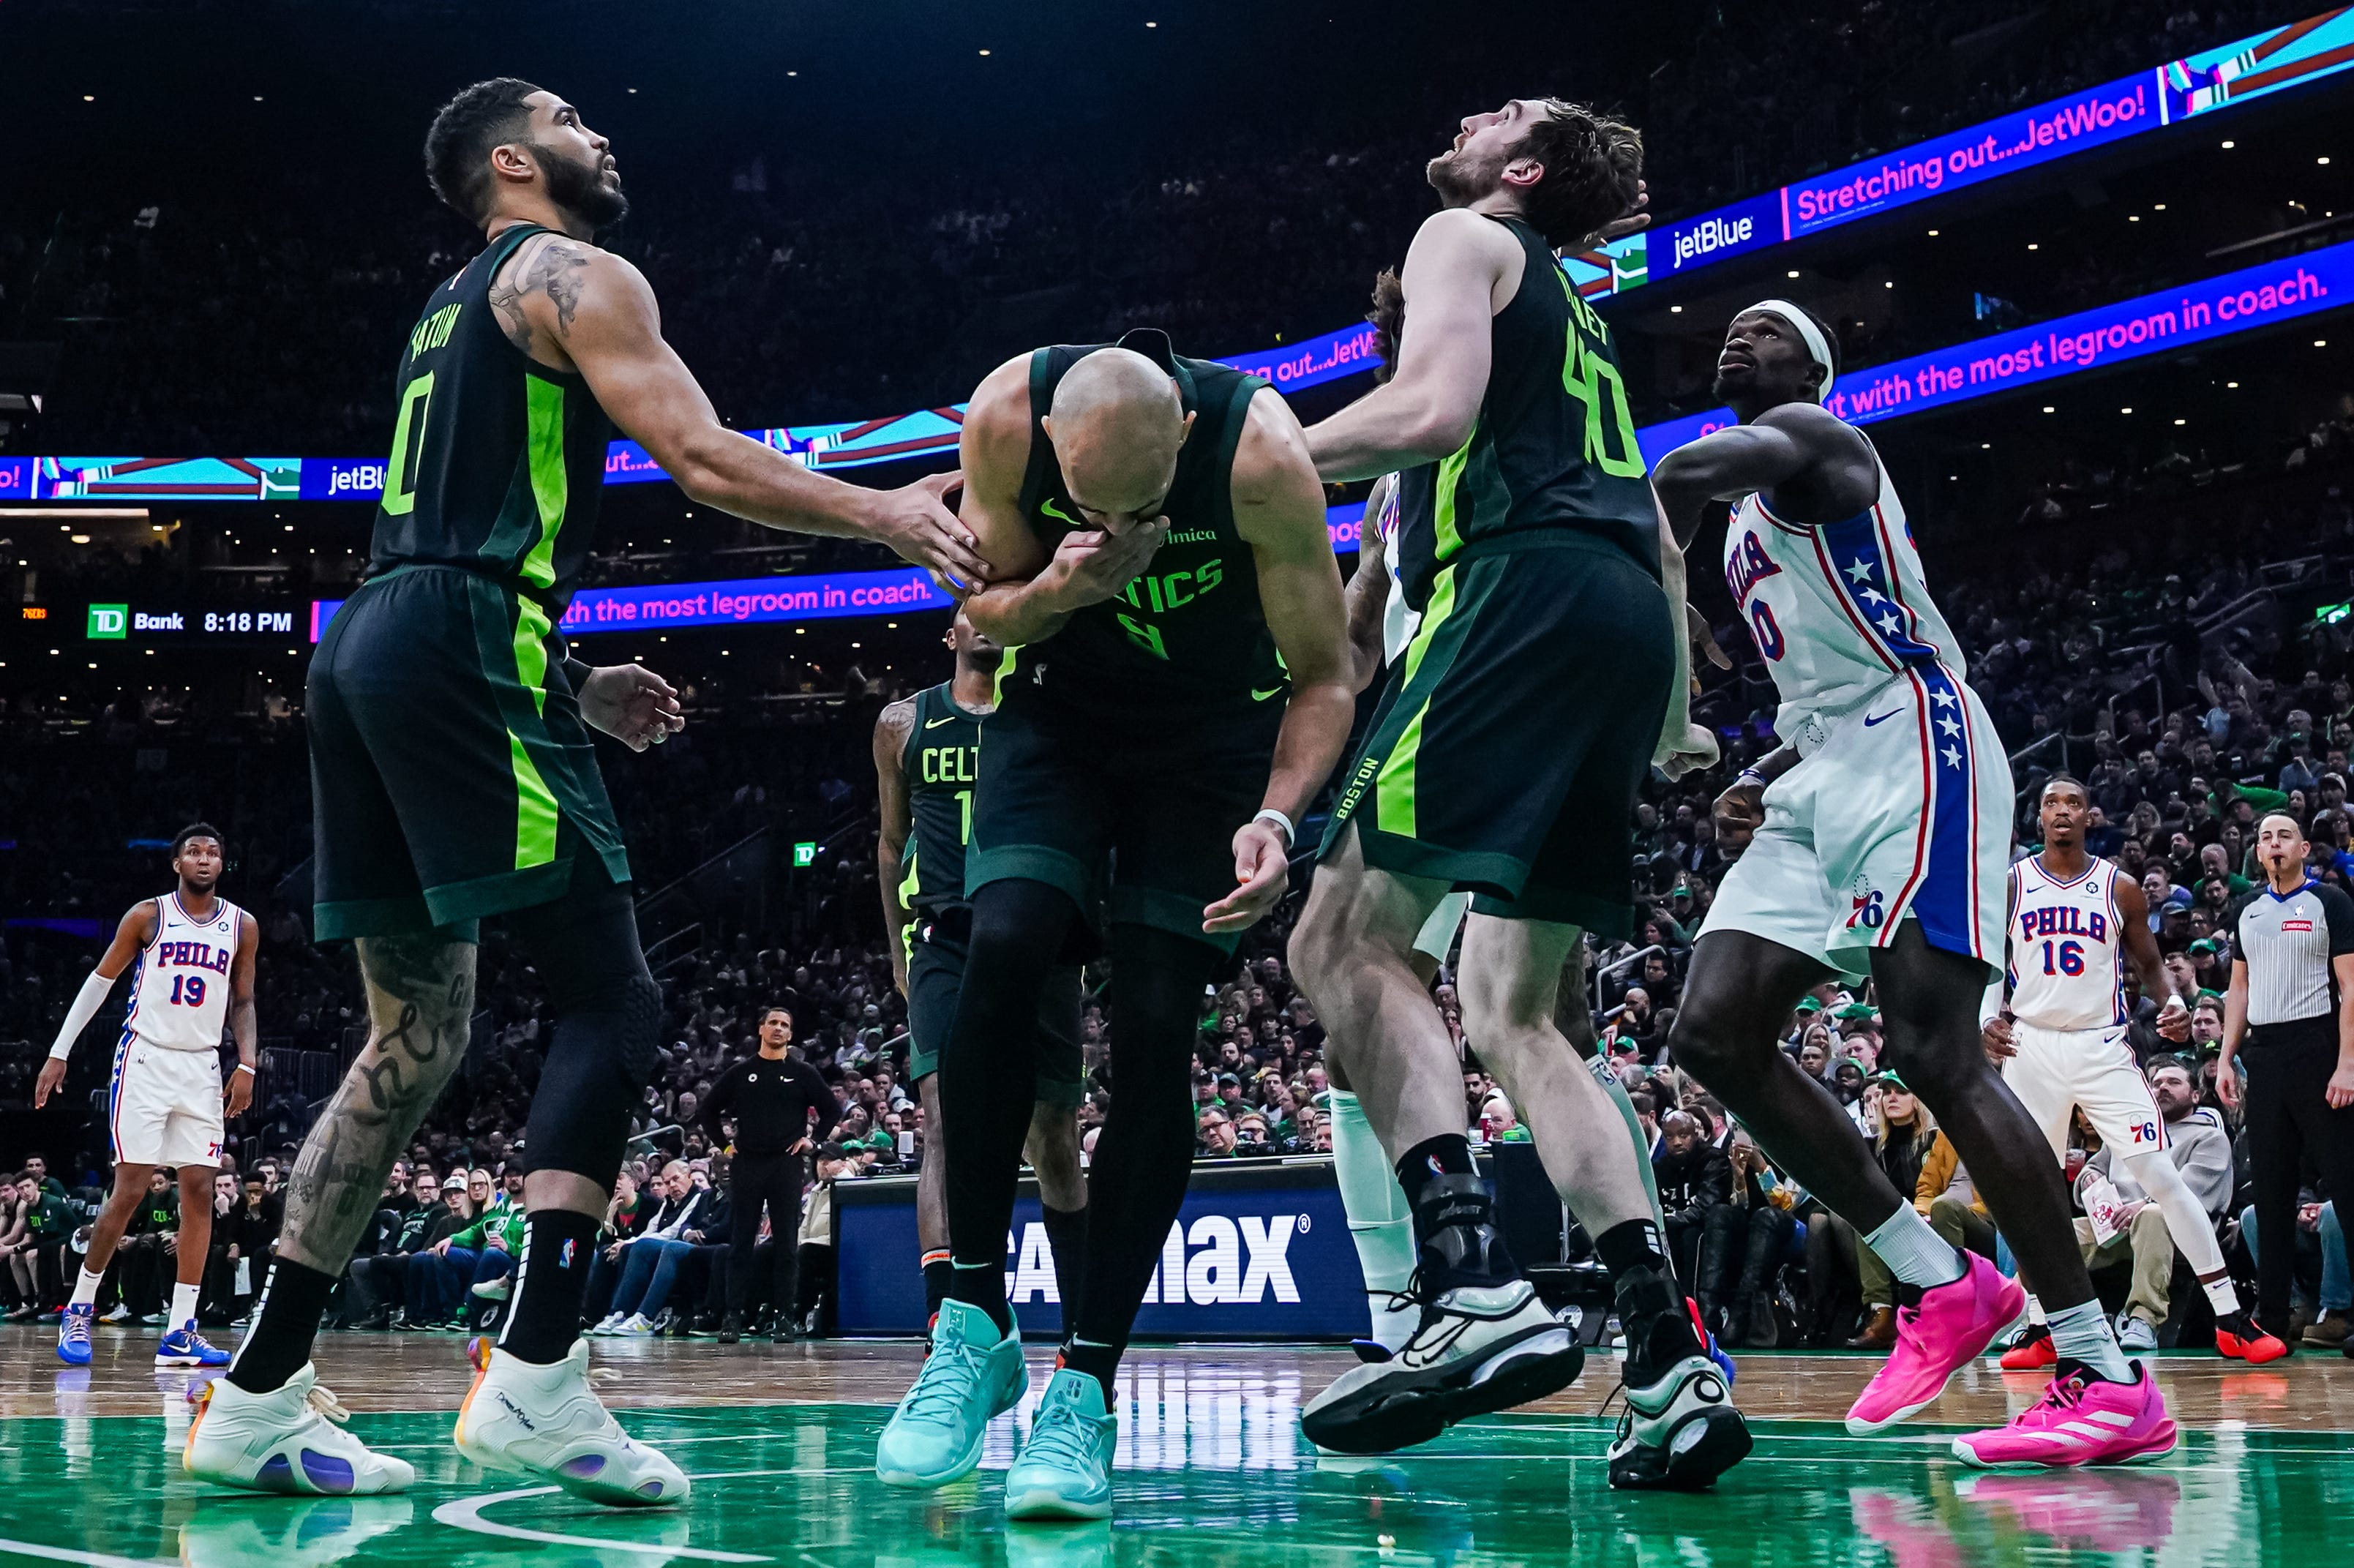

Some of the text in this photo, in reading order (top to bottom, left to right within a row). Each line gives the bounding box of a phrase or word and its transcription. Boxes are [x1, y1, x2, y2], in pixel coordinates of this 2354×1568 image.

[1798, 157, 1943, 220] Stretching
[1673, 217, 1753, 269] jetBlue
[1851, 374, 1911, 413] with
[1916, 364, 1963, 397] the
[1970, 340, 2044, 384] most
[2050, 312, 2176, 366] legroom
[2183, 299, 2211, 330] in
[2218, 268, 2328, 321] coach.
[1562, 317, 1646, 479] 40
[381, 370, 435, 515] 0
[329, 465, 386, 495] jetBl
[595, 599, 637, 621] the
[642, 594, 707, 619] most
[712, 591, 818, 620] legroom
[824, 585, 846, 608] in
[851, 577, 932, 607] coach.
[1125, 559, 1223, 612] TICS
[92, 610, 184, 632] TD Bank
[204, 613, 292, 631] 8:18 PM
[1337, 757, 1379, 820] BOSTON
[796, 847, 815, 862] TD
[1845, 890, 1883, 928] 76
[2020, 906, 2106, 945] PHILA
[158, 942, 229, 975] PHILA
[2042, 940, 2085, 977] 16
[170, 974, 206, 1007] 19
[2130, 1122, 2156, 1144] 76
